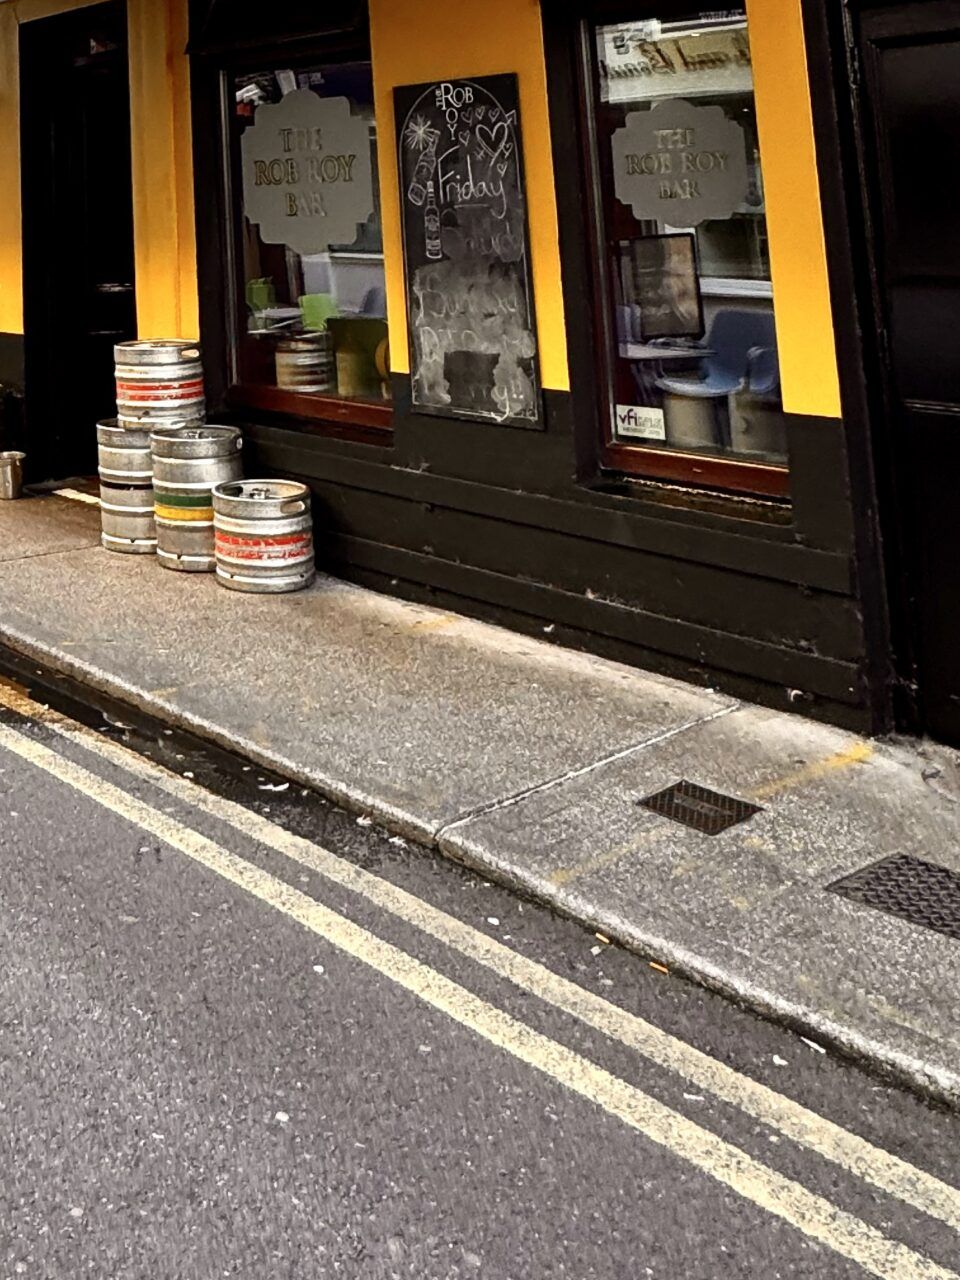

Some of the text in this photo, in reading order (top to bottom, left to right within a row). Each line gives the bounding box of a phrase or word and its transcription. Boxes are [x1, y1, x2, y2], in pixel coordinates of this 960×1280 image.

[280, 128, 322, 152] THE
[653, 128, 695, 149] THE
[254, 154, 356, 185] ROB ROY
[625, 151, 728, 175] ROB ROY
[438, 145, 507, 219] Friday
[659, 179, 701, 199] BAR
[285, 192, 328, 217] BAR
